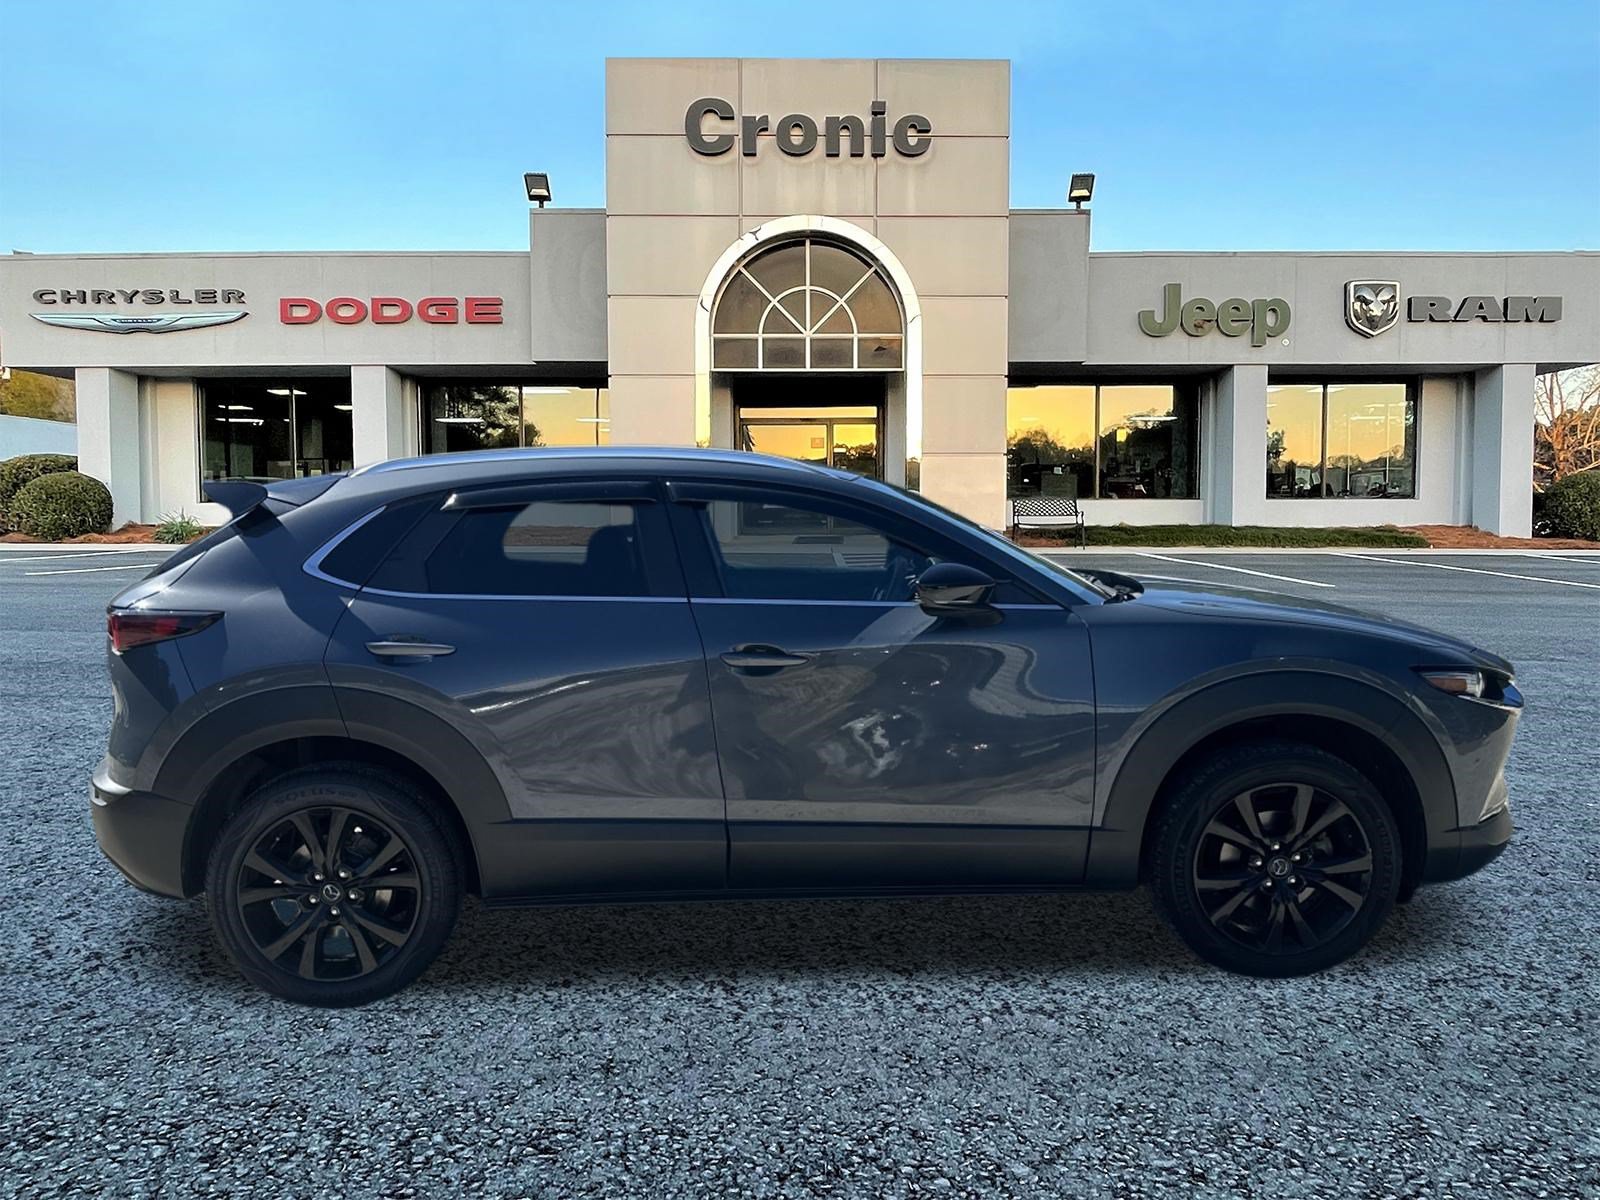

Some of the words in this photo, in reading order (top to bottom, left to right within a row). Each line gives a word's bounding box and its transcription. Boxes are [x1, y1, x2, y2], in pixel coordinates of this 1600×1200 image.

[684, 97, 932, 157] Cronic
[32, 288, 246, 305] CHRYSLER
[280, 296, 504, 325] DODGE
[1408, 296, 1563, 322] RAM
[1138, 282, 1291, 347] Jeep
